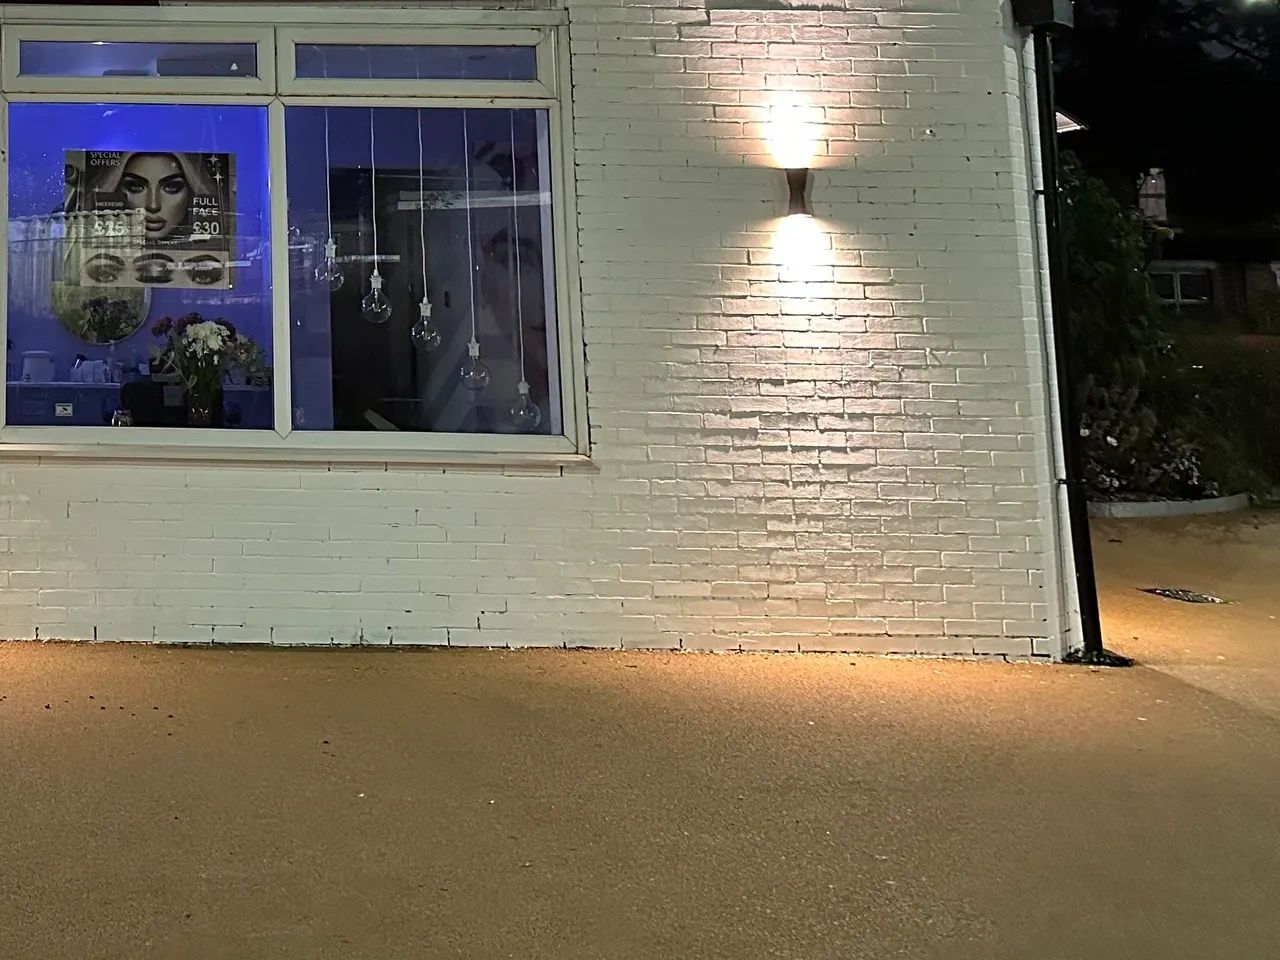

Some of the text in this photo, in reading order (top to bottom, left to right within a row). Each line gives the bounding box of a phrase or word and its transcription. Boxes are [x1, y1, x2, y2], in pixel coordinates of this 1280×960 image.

[90, 151, 120, 159] SPECIAL
[90, 158, 121, 166] OFFERS
[192, 197, 219, 206] FULL
[192, 208, 219, 216] FACE
[192, 221, 220, 235] £30
